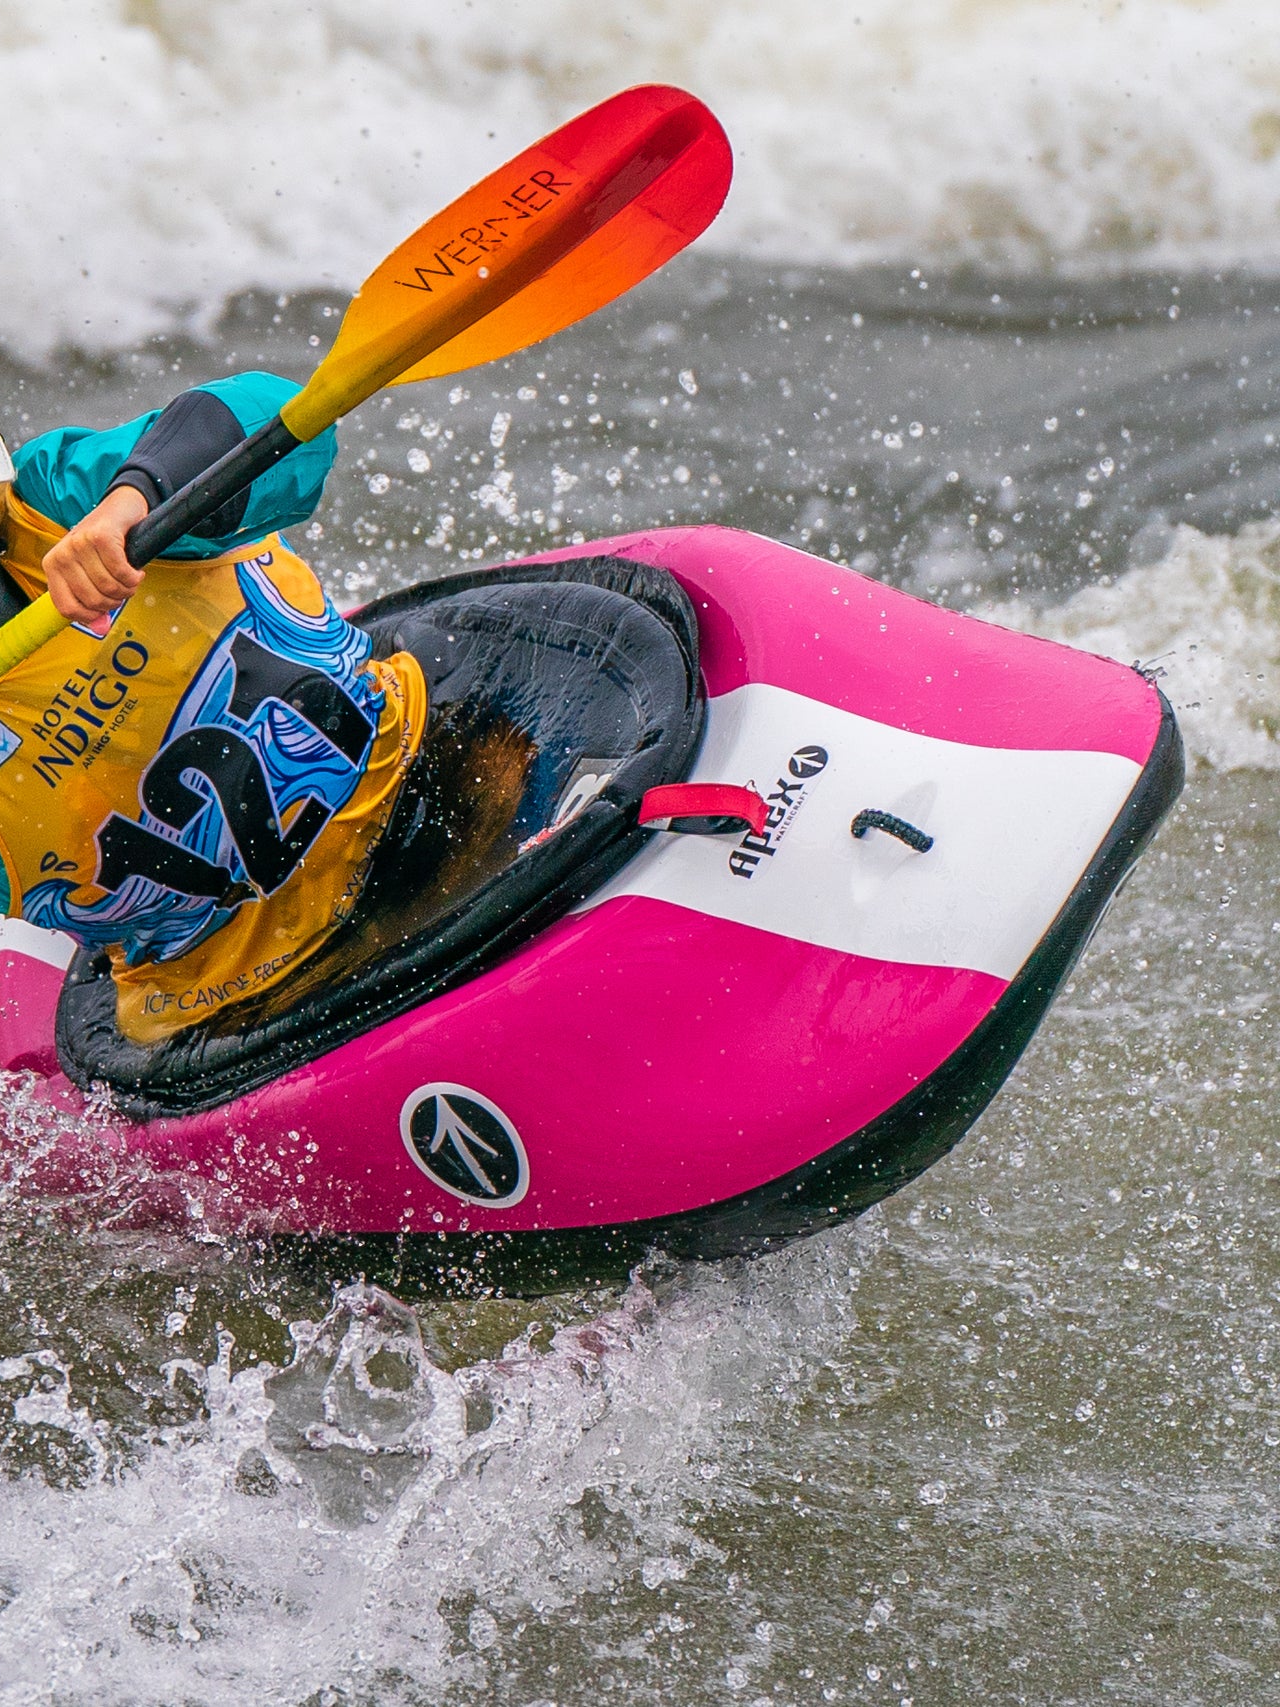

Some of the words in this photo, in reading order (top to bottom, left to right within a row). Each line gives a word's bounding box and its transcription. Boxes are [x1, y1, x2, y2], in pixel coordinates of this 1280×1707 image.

[394, 170, 572, 292] WERNER
[31, 667, 97, 742] HOTEL
[32, 640, 149, 788] INDIGO
[82, 754, 96, 769] AN
[109, 698, 138, 732] HOTEL
[93, 629, 375, 901] 121
[775, 791, 809, 842] WATERCRAFT
[142, 992, 175, 1015] ICF
